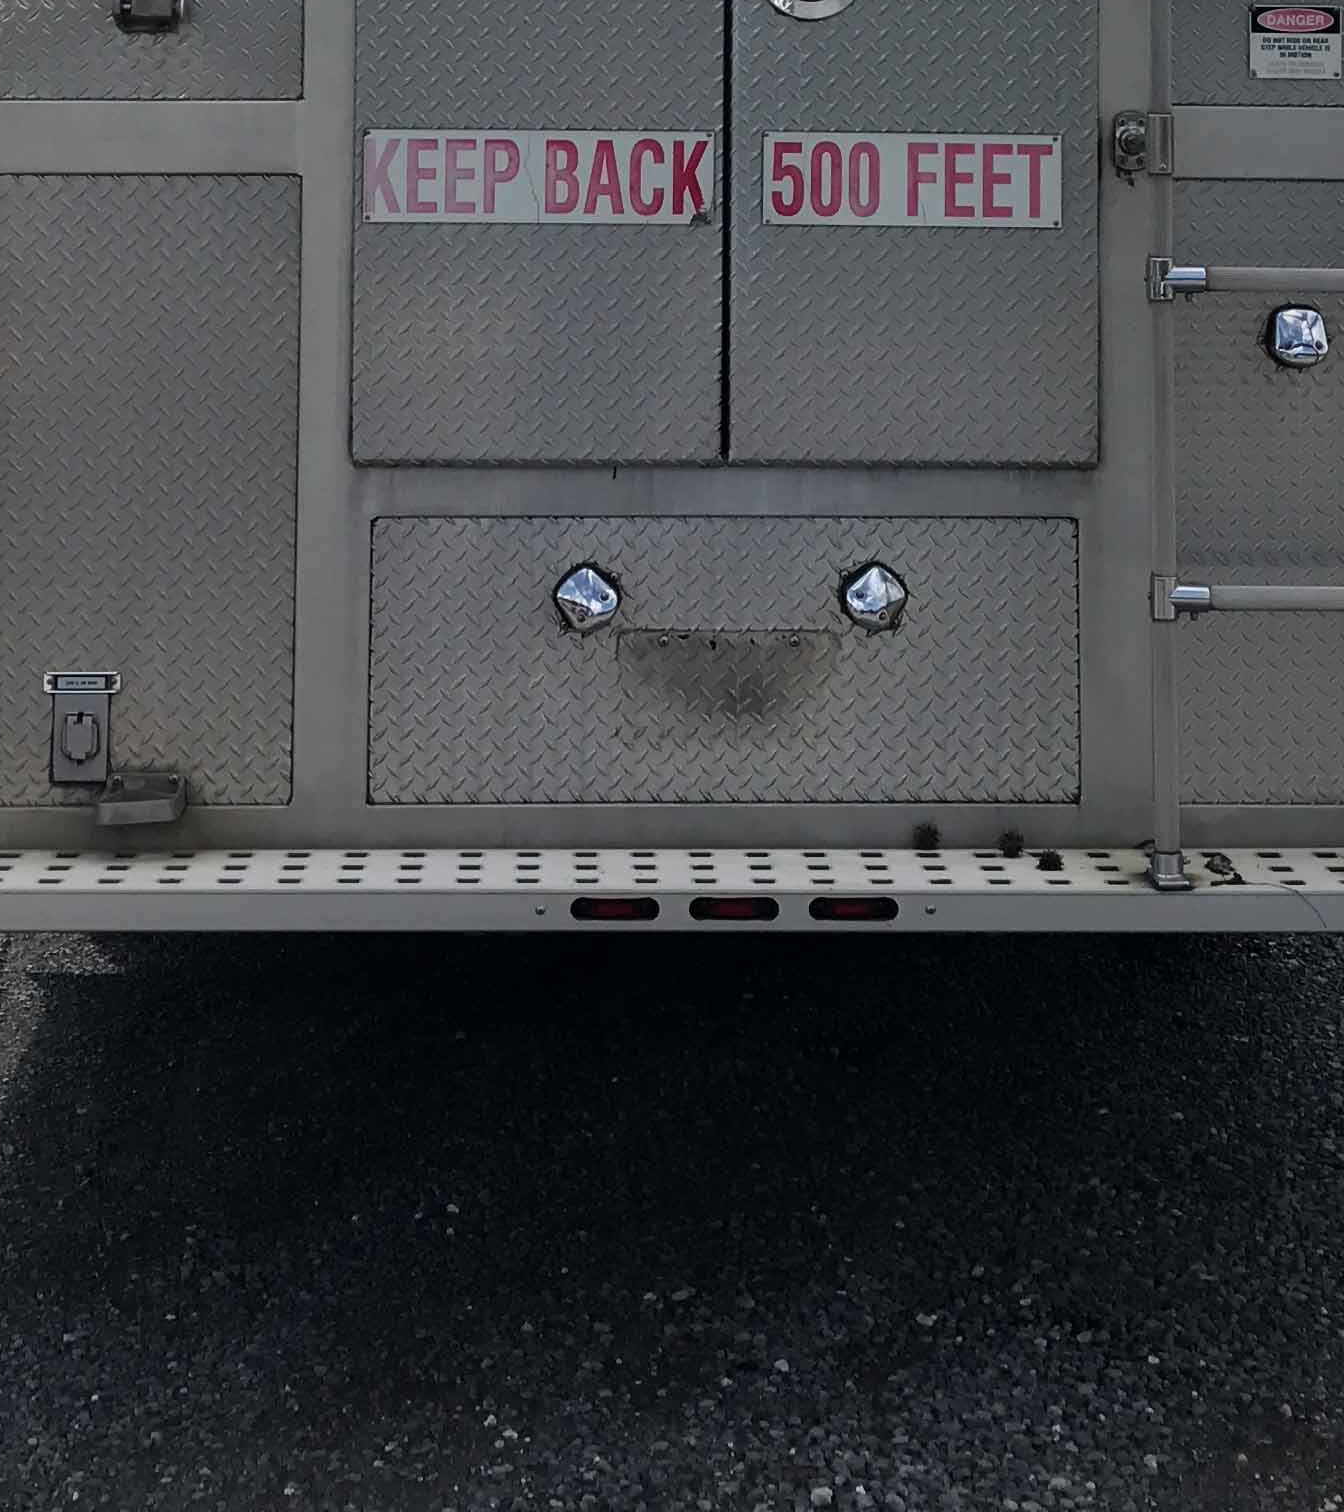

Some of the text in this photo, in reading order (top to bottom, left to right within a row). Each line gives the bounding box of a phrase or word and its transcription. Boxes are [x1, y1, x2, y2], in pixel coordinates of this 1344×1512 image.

[1266, 14, 1325, 26] DANGER
[365, 137, 1054, 219] KEEP BACK 500 FEET
